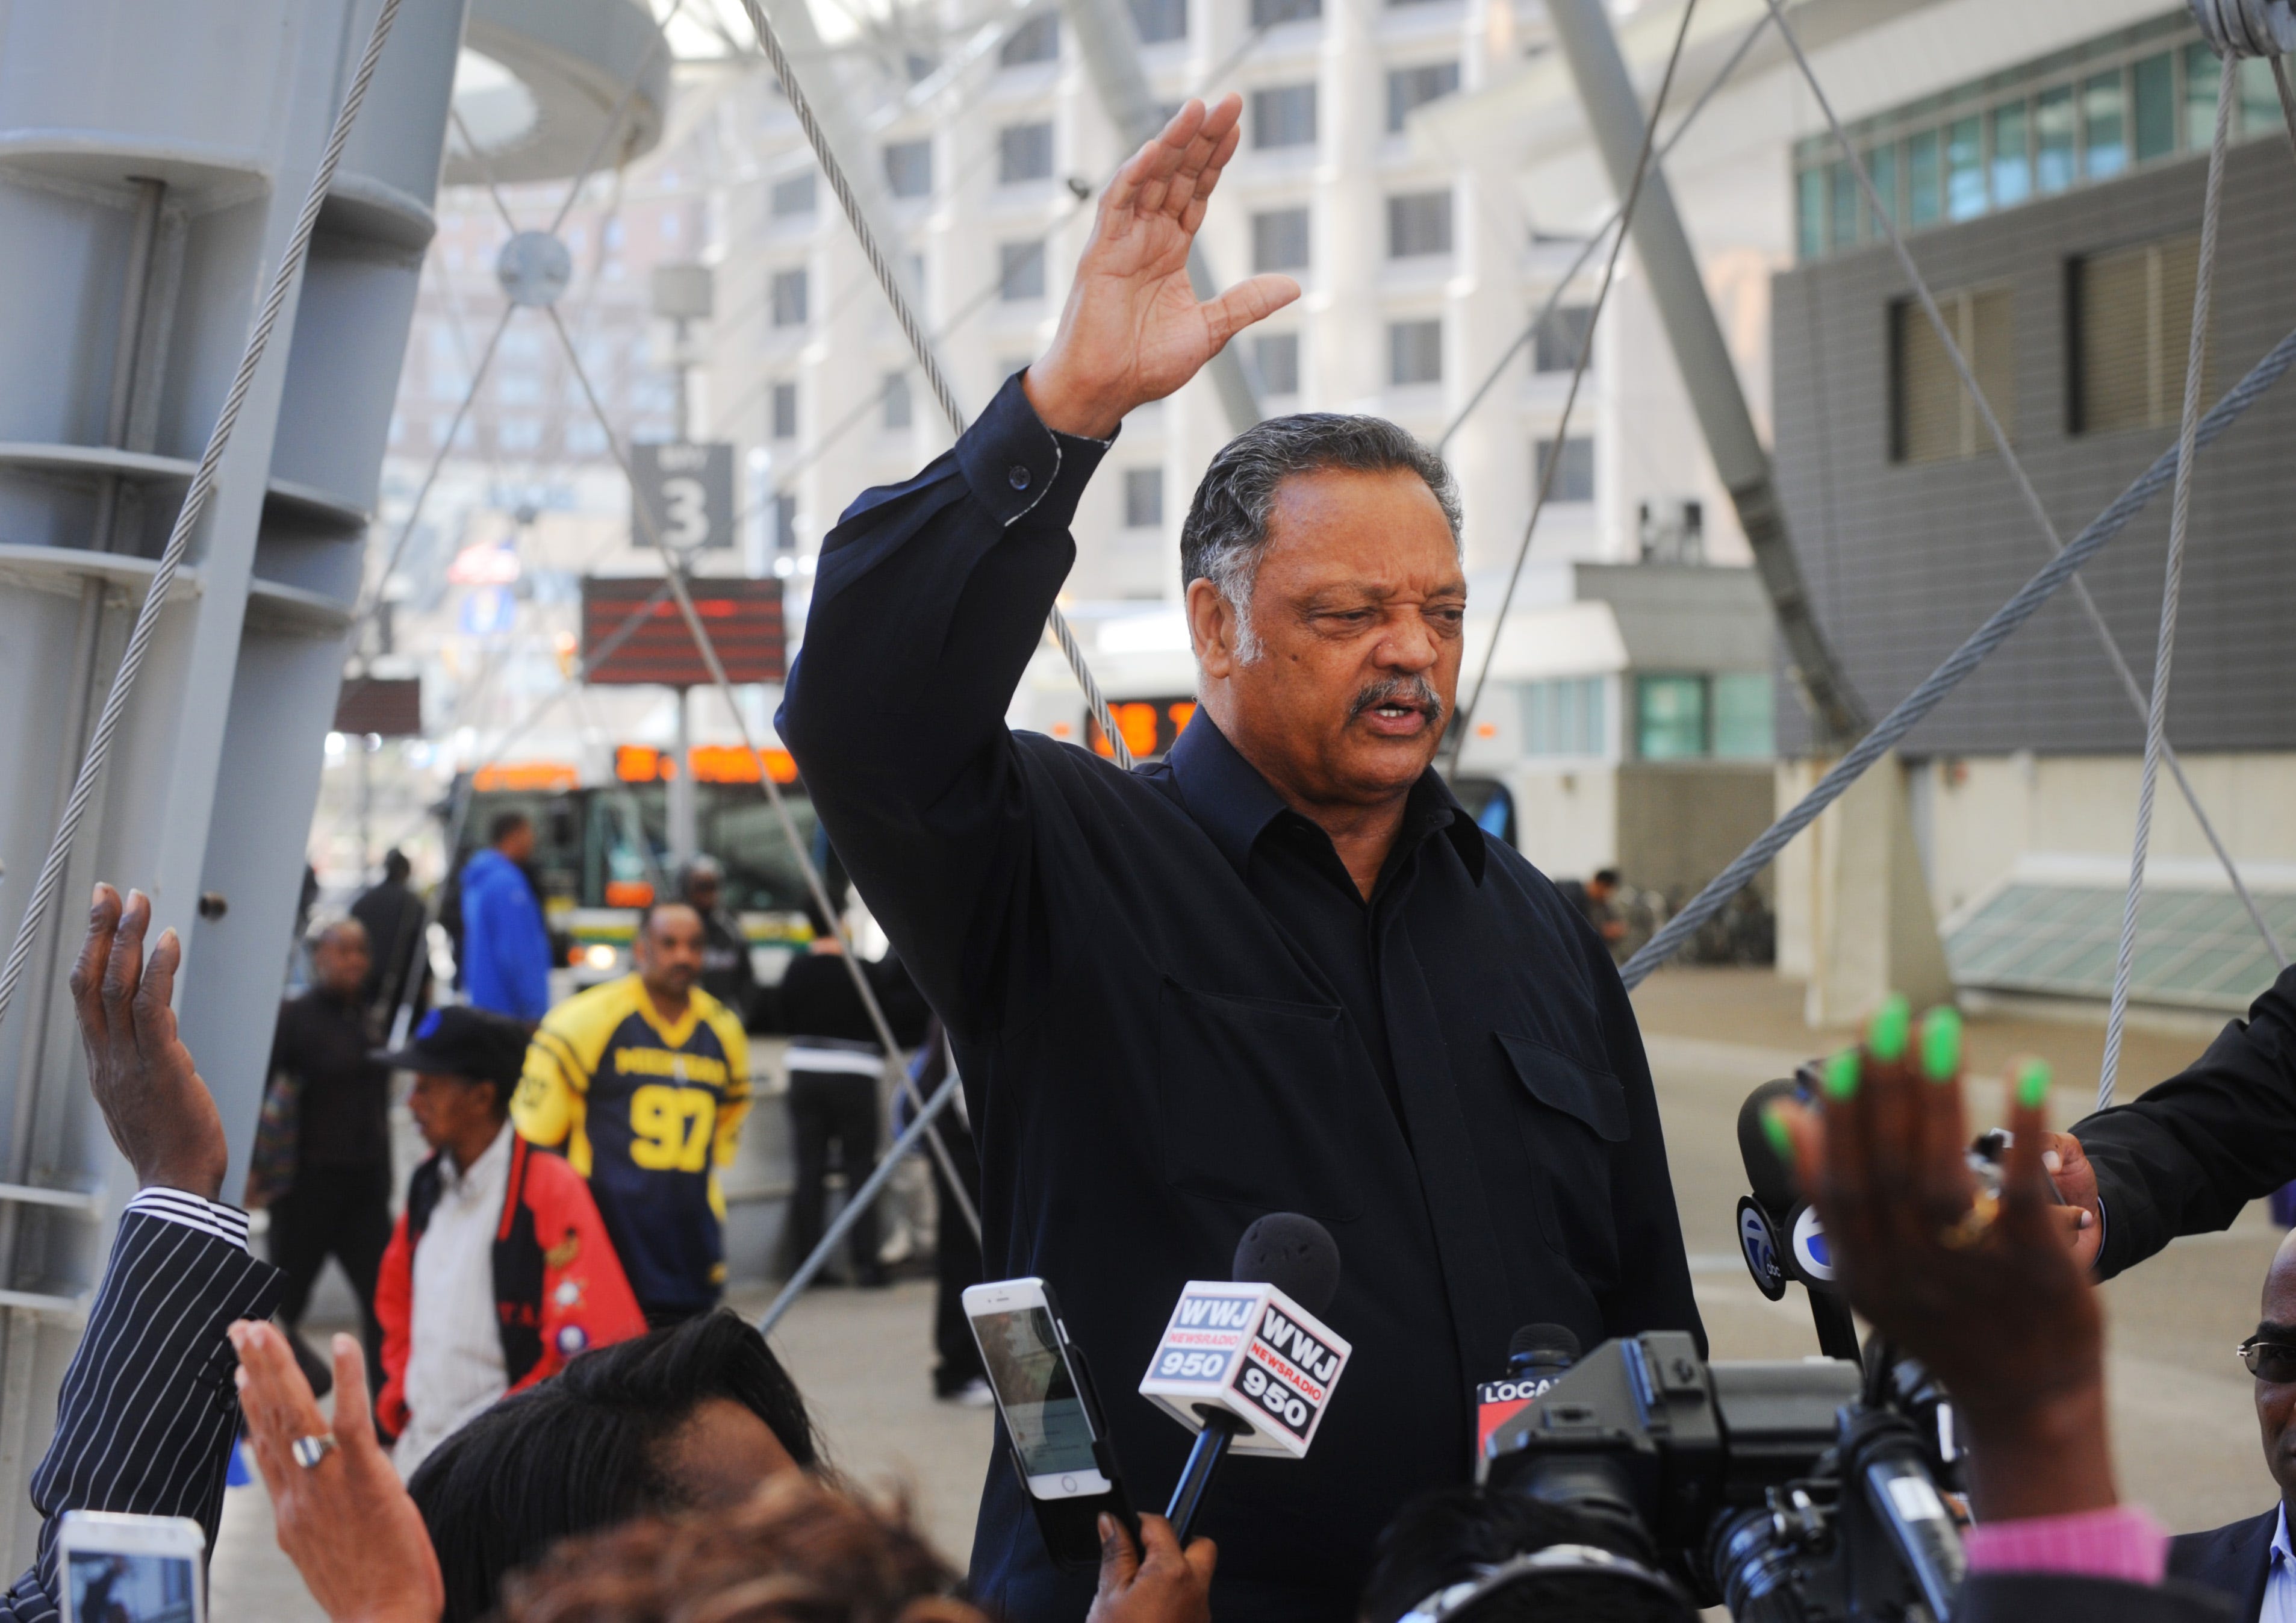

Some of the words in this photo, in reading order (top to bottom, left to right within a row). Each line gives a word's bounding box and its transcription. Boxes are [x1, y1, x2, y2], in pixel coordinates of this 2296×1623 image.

[661, 477, 710, 548] 3
[630, 1084, 716, 1173] 97
[1766, 1260, 1781, 1277] abc
[1180, 1299, 1255, 1328] WWJ
[1170, 1332, 1240, 1345] NEWSRADIO
[1262, 1307, 1338, 1382] WWJ
[1160, 1352, 1224, 1377] 950
[1251, 1342, 1321, 1401] NEWSRADIO
[1243, 1368, 1307, 1427] 950
[1485, 1378, 1560, 1403] LOCA
